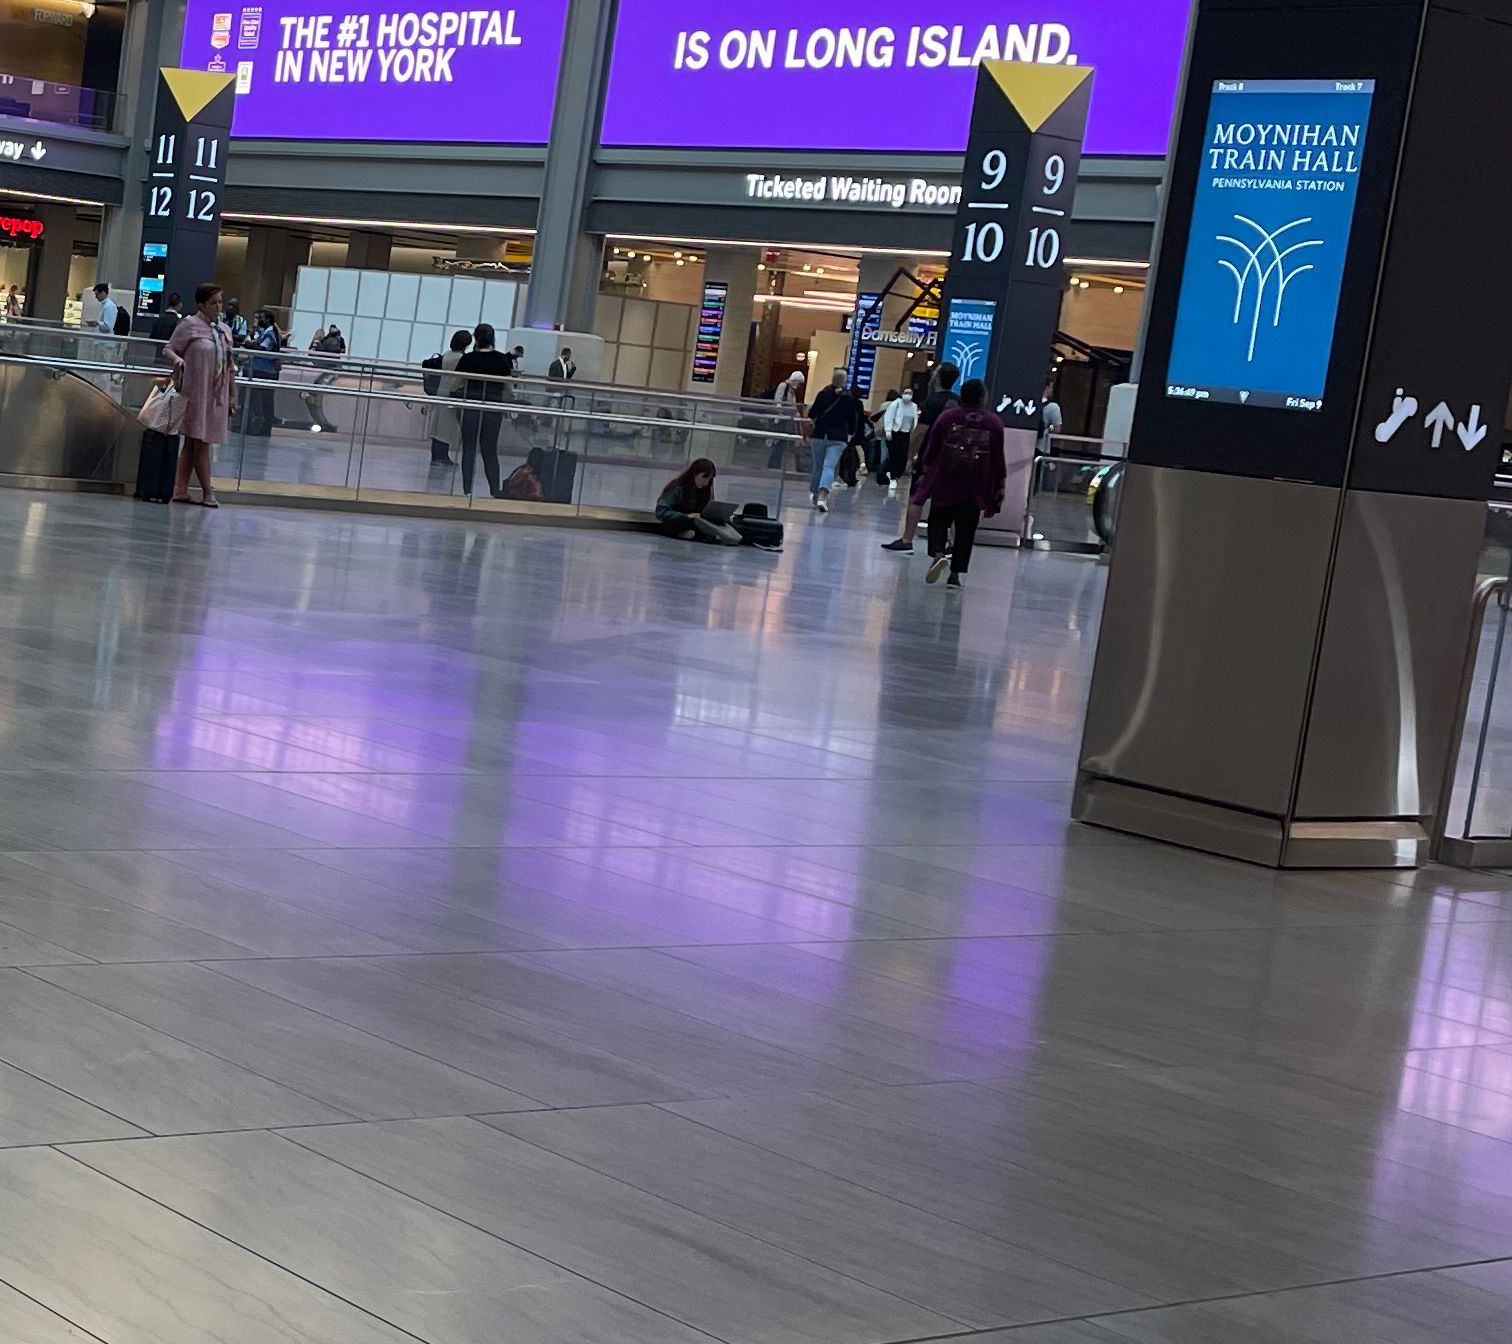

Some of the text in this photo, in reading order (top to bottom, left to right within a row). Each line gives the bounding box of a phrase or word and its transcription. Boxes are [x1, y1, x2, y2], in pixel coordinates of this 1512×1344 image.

[279, 15, 333, 49] THE
[337, 14, 370, 48] #1
[376, 9, 522, 48] HOSPITAL
[674, 22, 1078, 70] IS ON LONG ISLAND.
[274, 47, 457, 83] IN NEW YORK
[156, 134, 175, 164] 11
[1213, 123, 1361, 147] MOYNIHAN
[195, 137, 218, 169] 11
[980, 149, 1008, 191] 9
[1209, 148, 1358, 173] TRAIN HALL
[746, 173, 827, 201] Ticketed
[831, 176, 903, 208] Waiting
[1042, 154, 1066, 196] 9
[1212, 177, 1345, 192] PENNSYLVANIA STATION
[149, 186, 172, 217] 12
[186, 189, 216, 222] 12
[960, 221, 1005, 263] 10
[1024, 226, 1061, 269] 10
